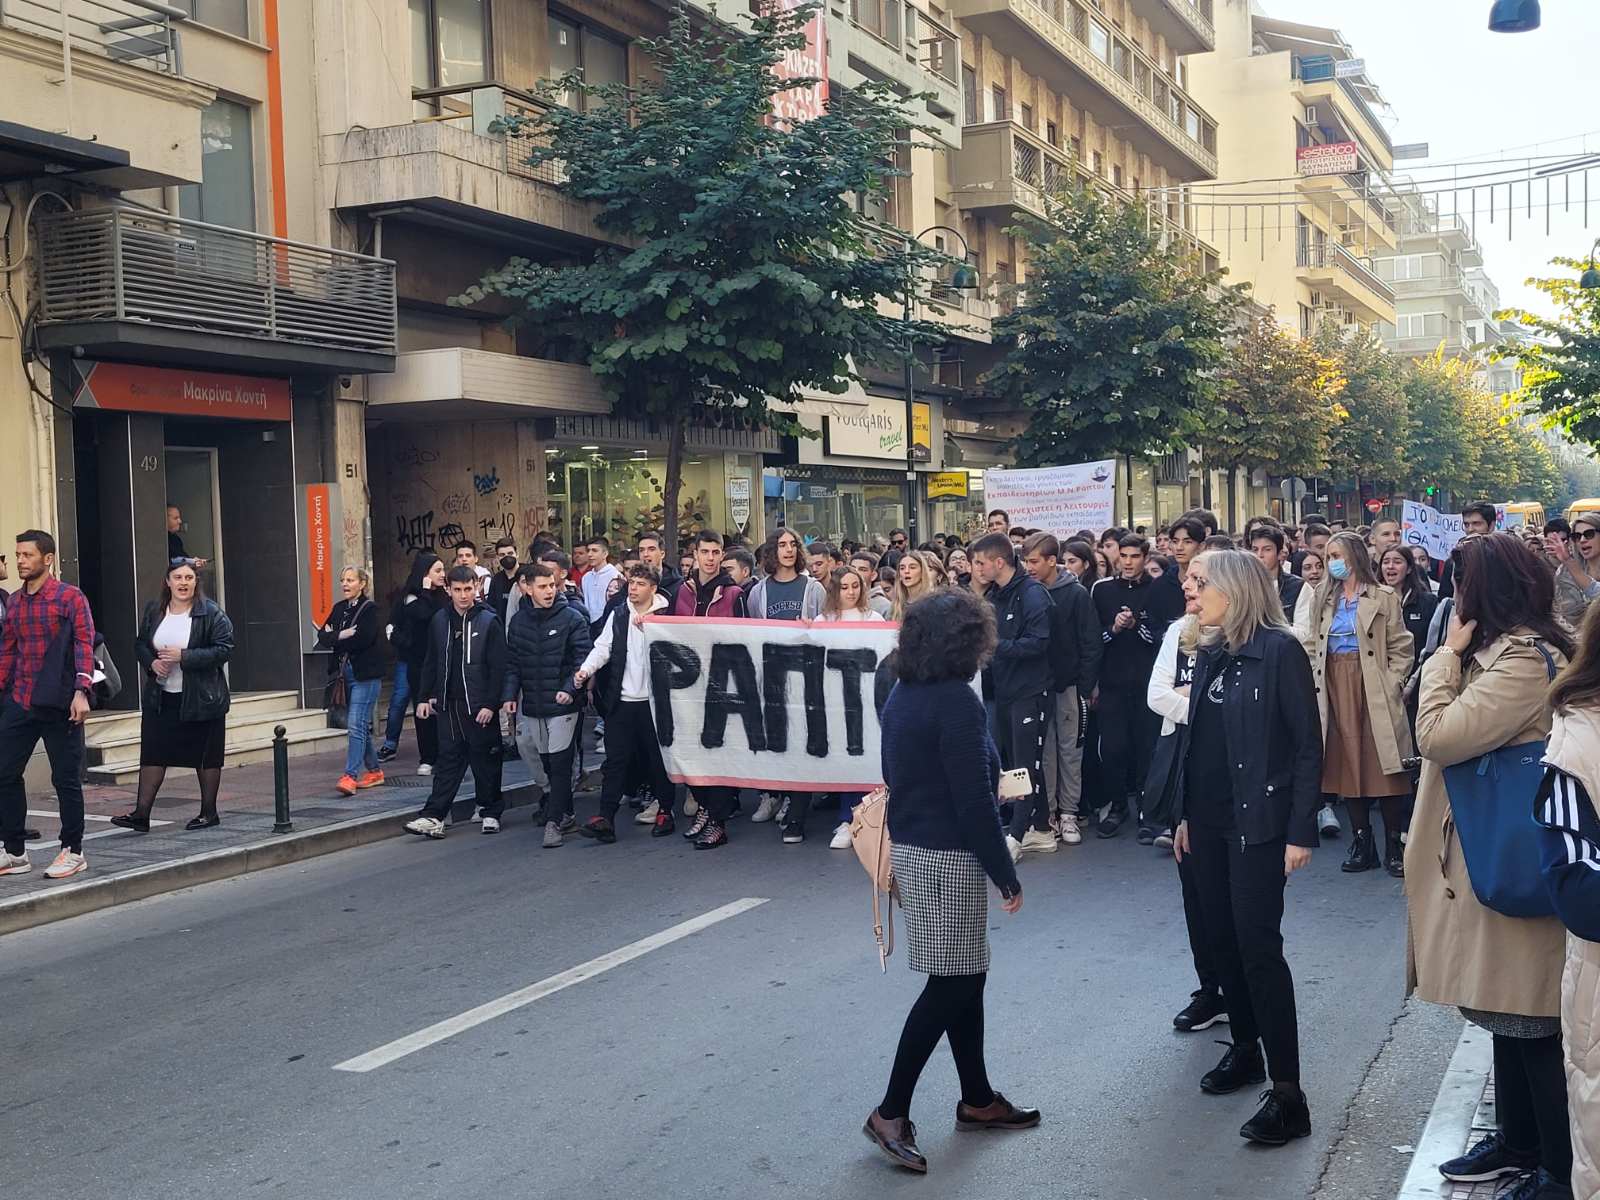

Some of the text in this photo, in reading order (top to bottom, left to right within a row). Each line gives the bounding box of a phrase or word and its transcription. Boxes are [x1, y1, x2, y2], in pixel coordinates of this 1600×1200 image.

[1303, 144, 1353, 158] estetico
[183, 381, 232, 405] Μακρίνα
[235, 386, 267, 409] Χοντή
[141, 455, 157, 471] 49
[346, 464, 358, 478] 51
[314, 495, 323, 526] Χοντή
[315, 528, 326, 571] Μακρίνα
